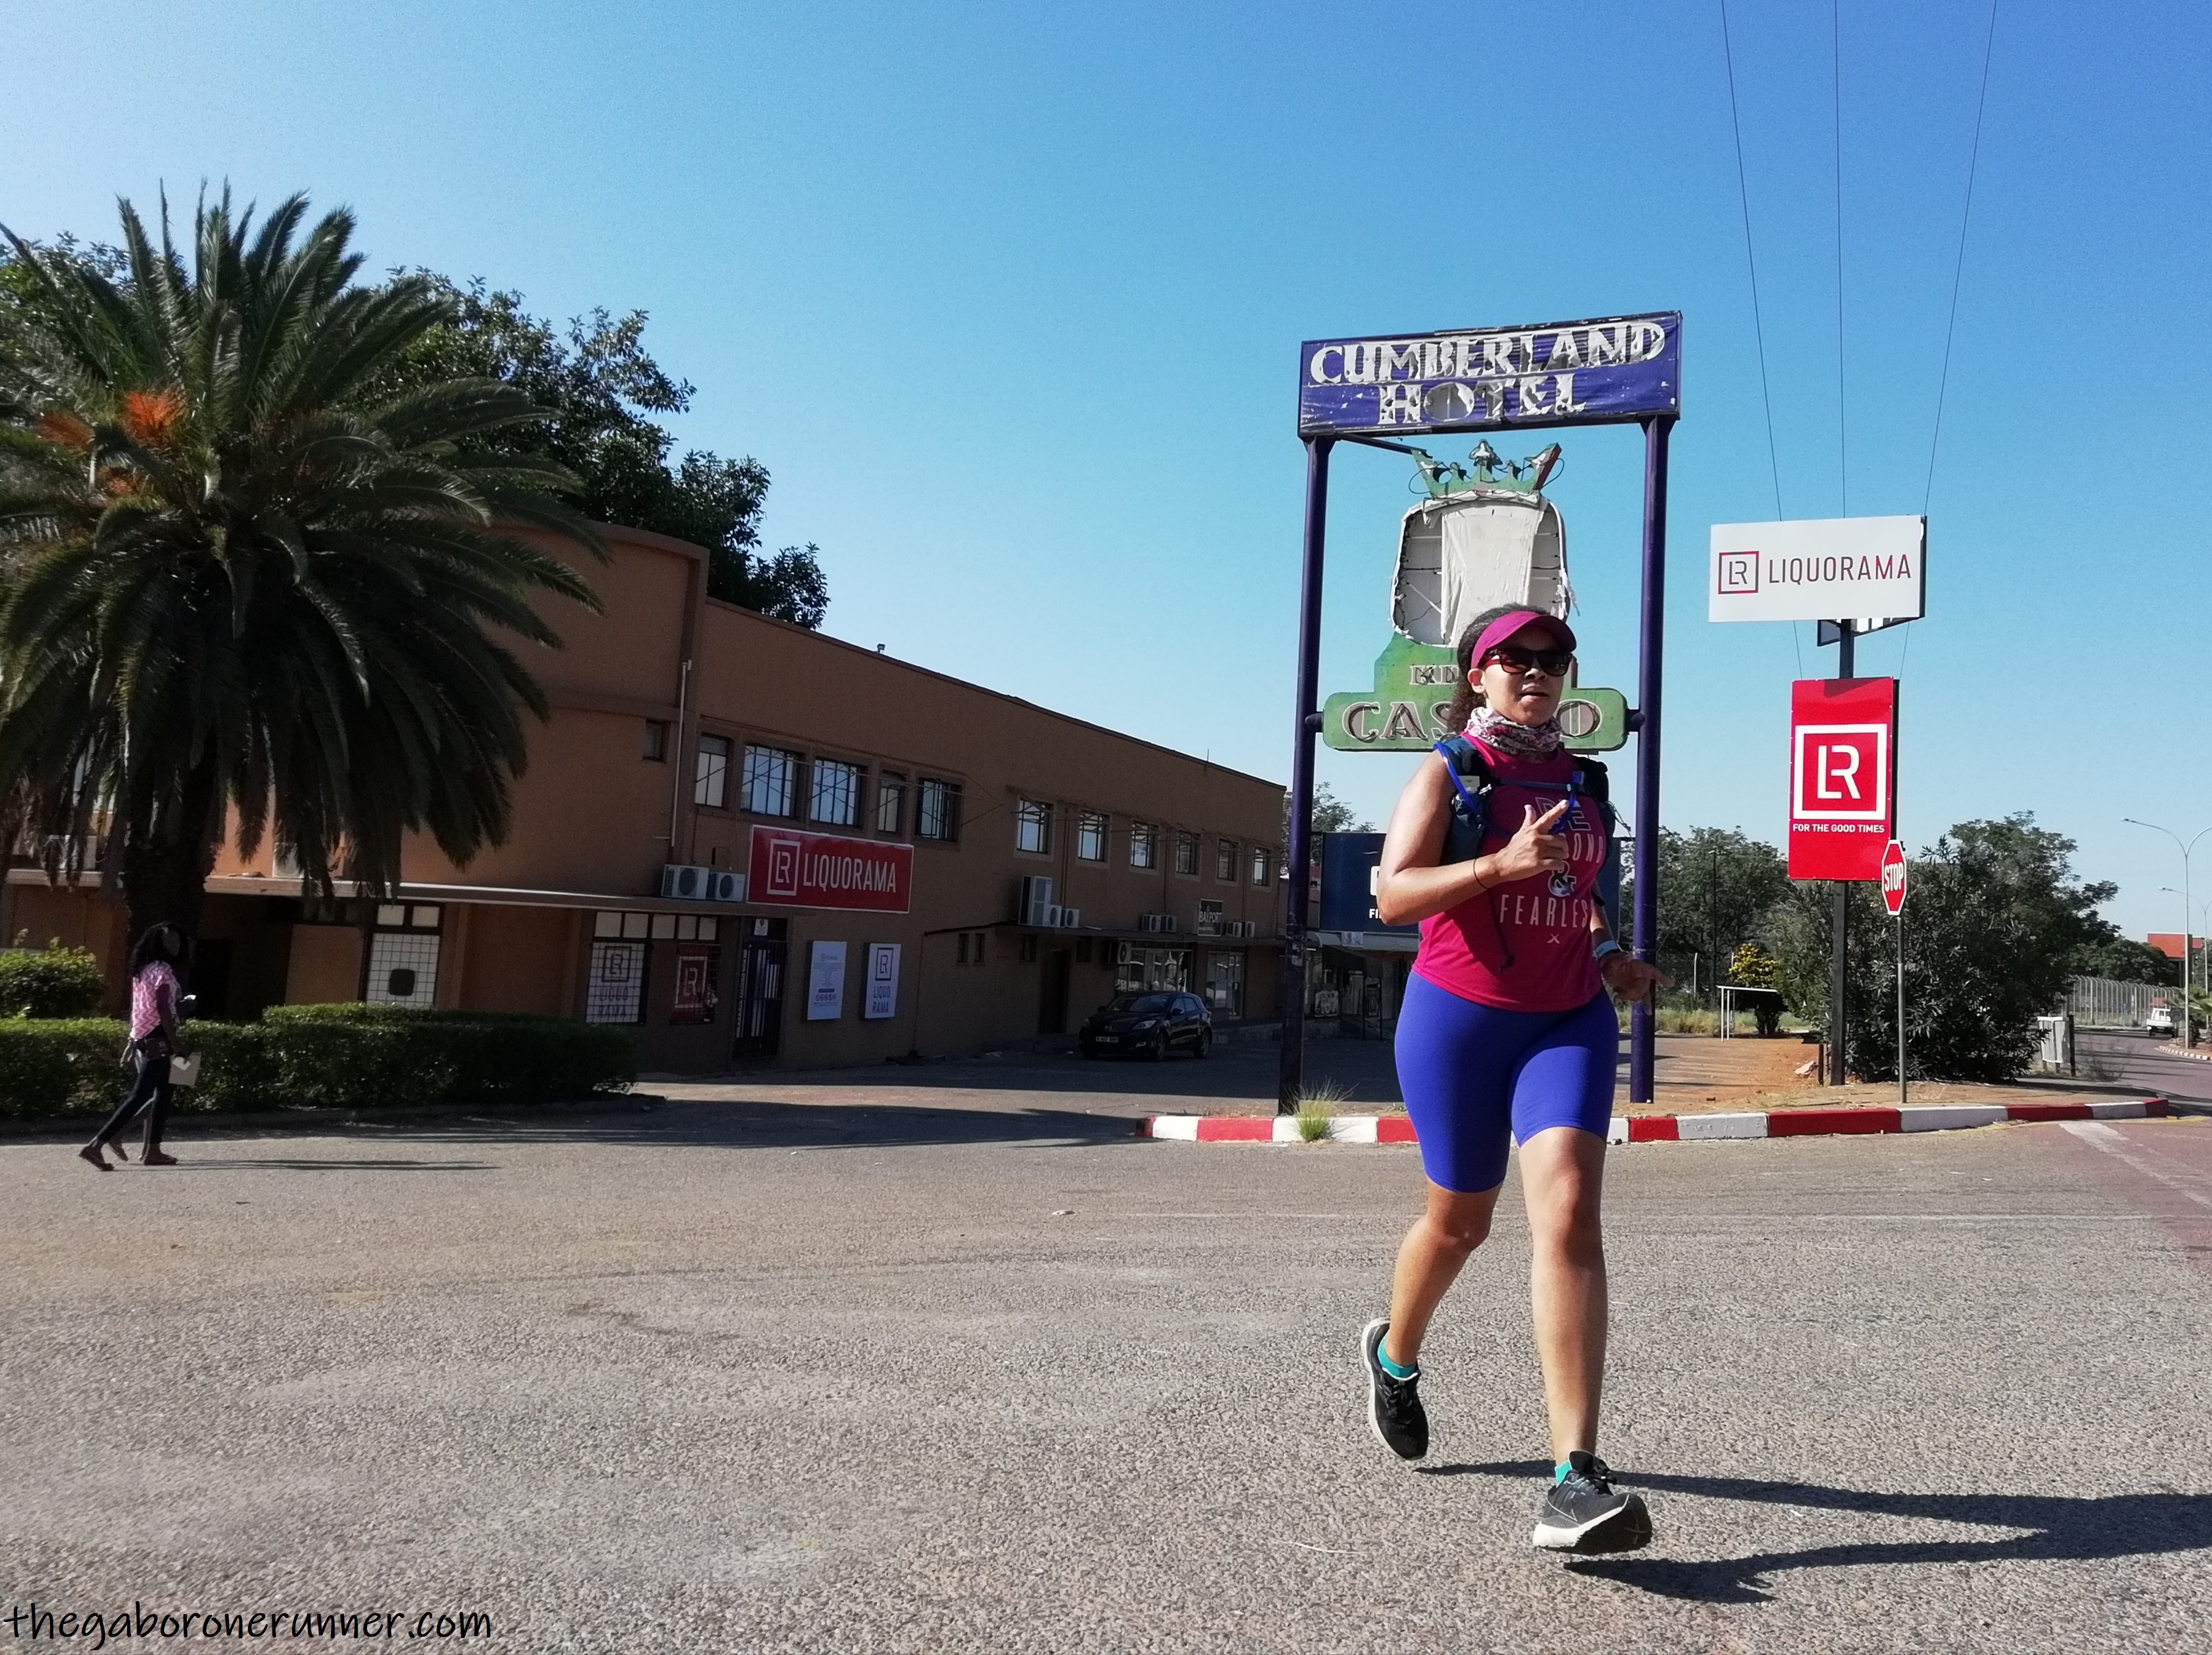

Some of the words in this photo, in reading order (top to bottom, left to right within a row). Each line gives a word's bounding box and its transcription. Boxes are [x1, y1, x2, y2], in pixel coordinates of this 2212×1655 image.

[1310, 321, 1665, 385] CUMBERLAND
[1377, 374, 1587, 424] HOTEL
[1769, 553, 1912, 585] LIQUORAMA
[1342, 698, 1603, 742] CASO
[1792, 823, 1810, 832] FOR
[1812, 823, 1829, 833] THE
[1831, 824, 1856, 834] GOOD
[1858, 824, 1885, 834] TIMES
[802, 853, 897, 893] LIQUORAMA
[1883, 861, 1904, 893] STOP
[1499, 893, 1593, 929] FEARLES
[871, 1001, 889, 1014] RAMA
[873, 985, 891, 999] LIQUO
